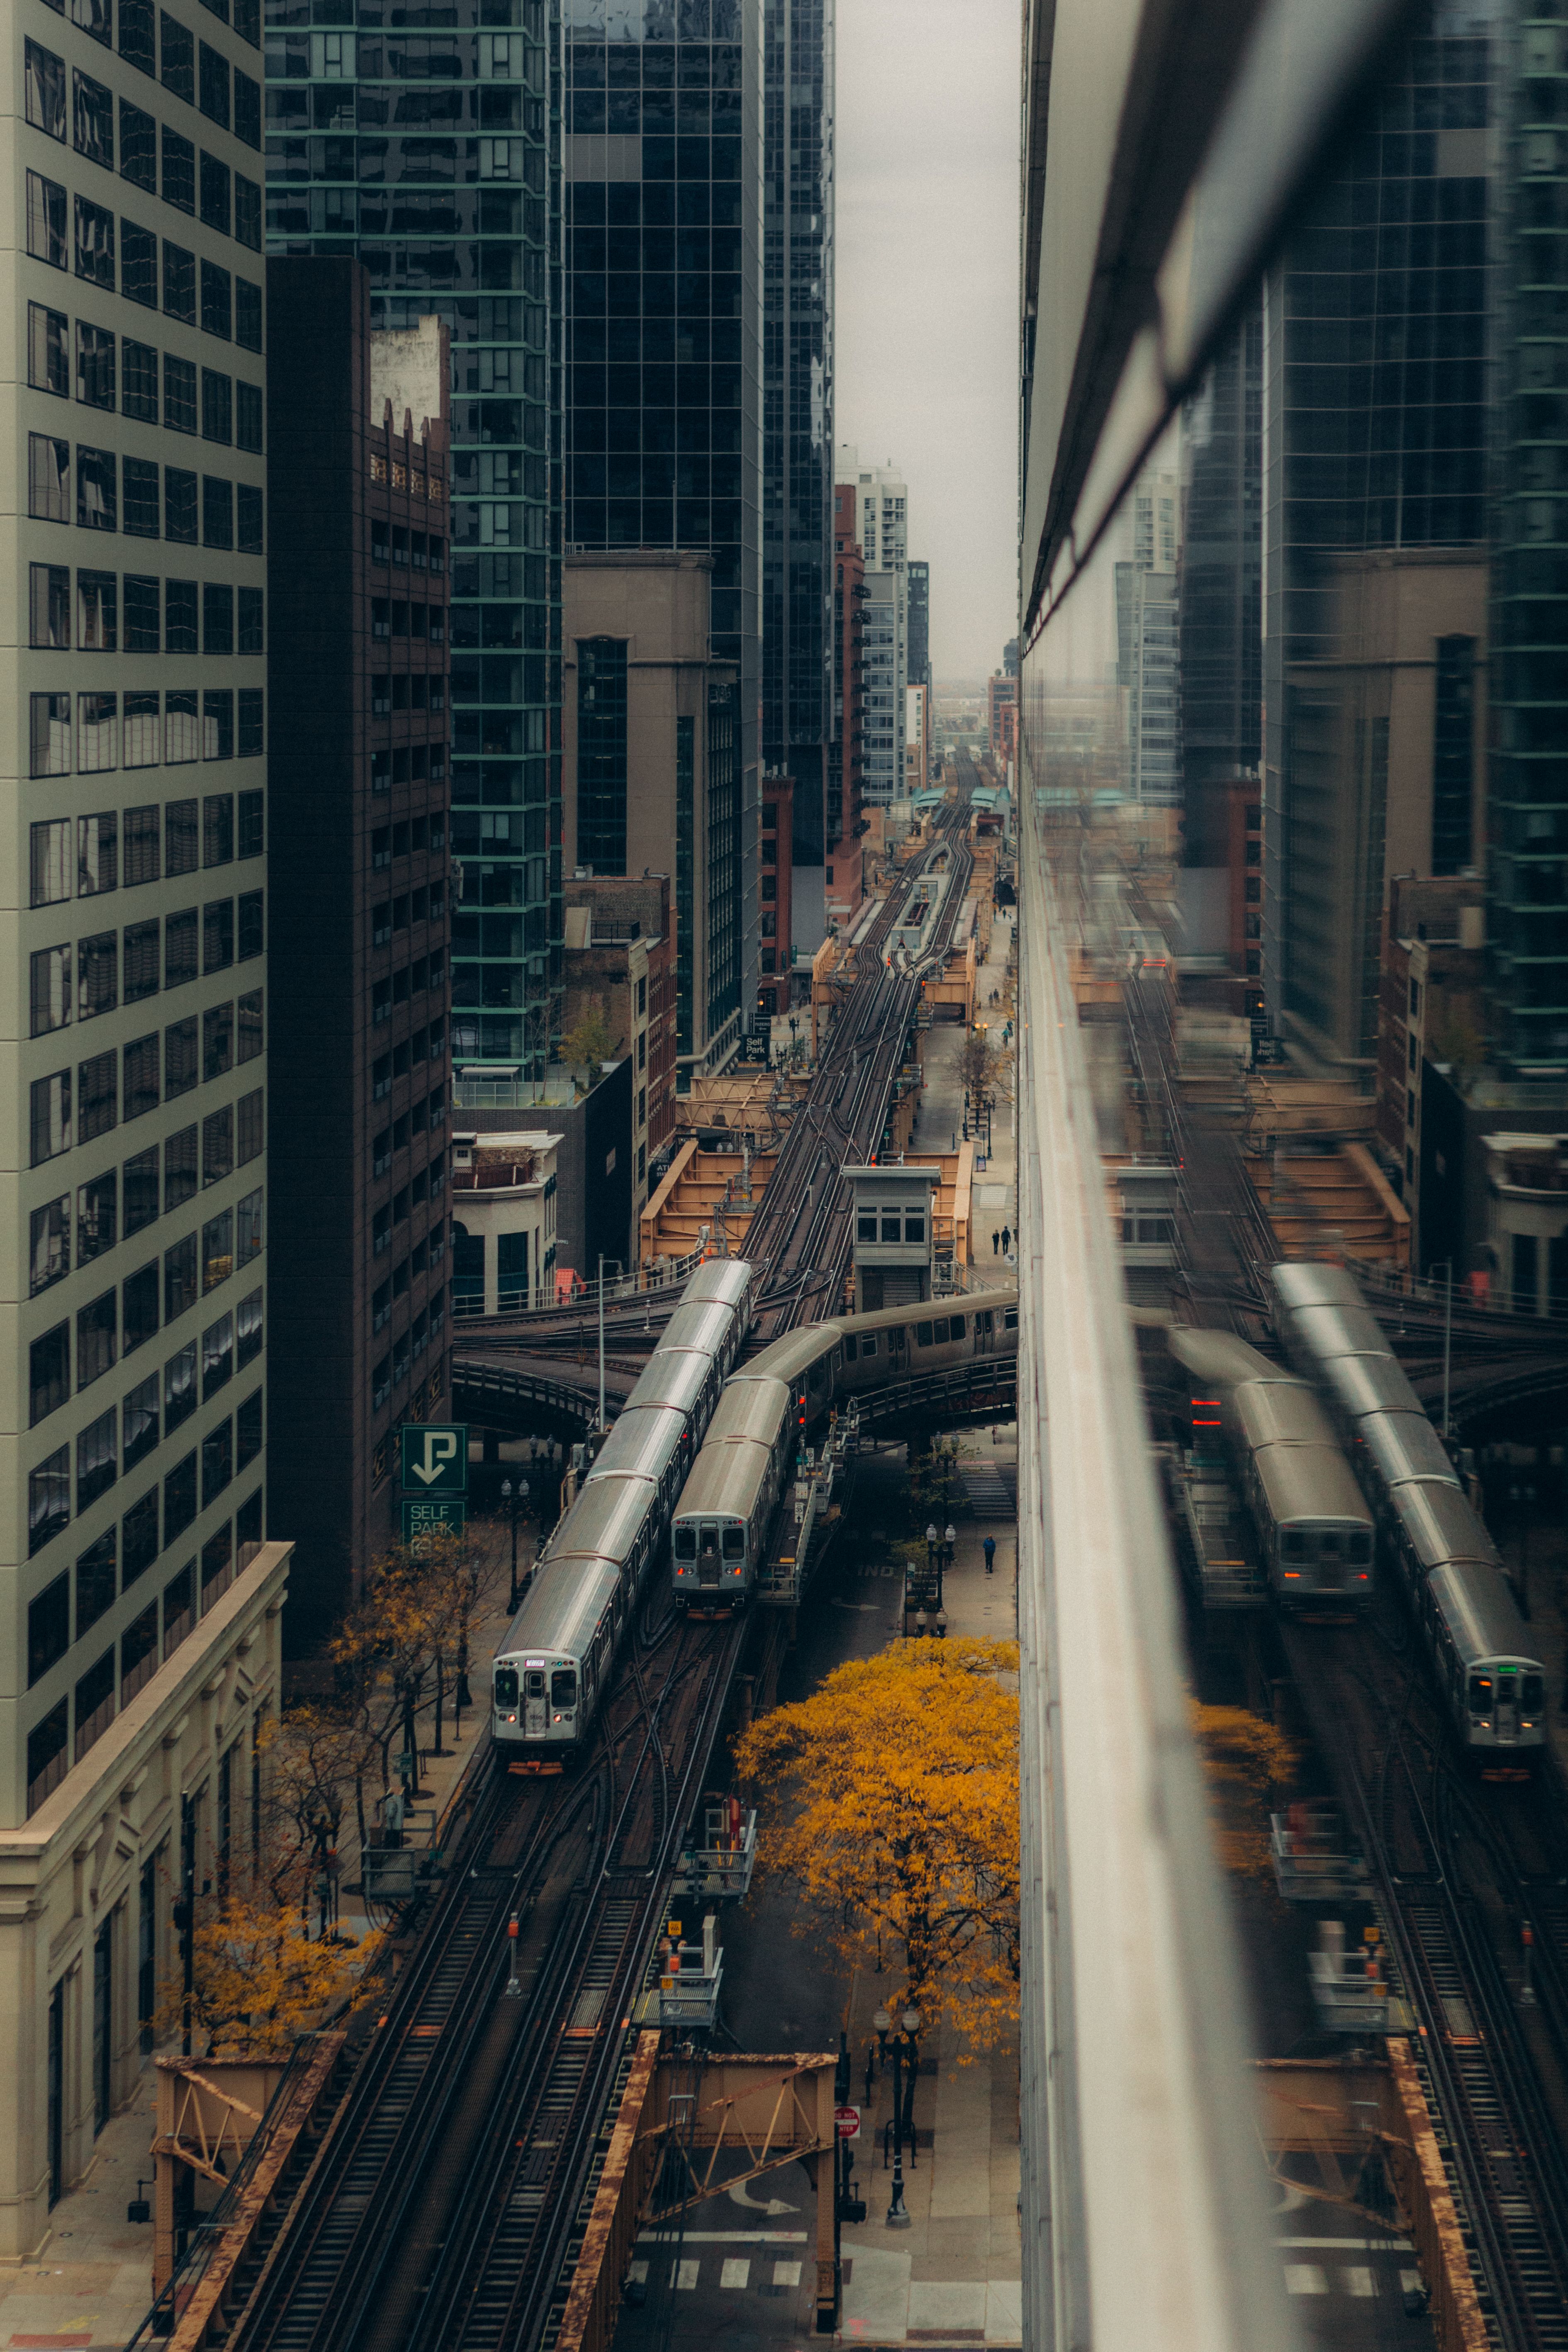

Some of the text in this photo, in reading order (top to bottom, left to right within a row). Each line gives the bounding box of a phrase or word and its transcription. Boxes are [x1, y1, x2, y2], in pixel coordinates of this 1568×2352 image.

[746, 1037, 763, 1046] Self
[411, 1505, 449, 1519] SELF
[411, 1522, 454, 1535] PARK
